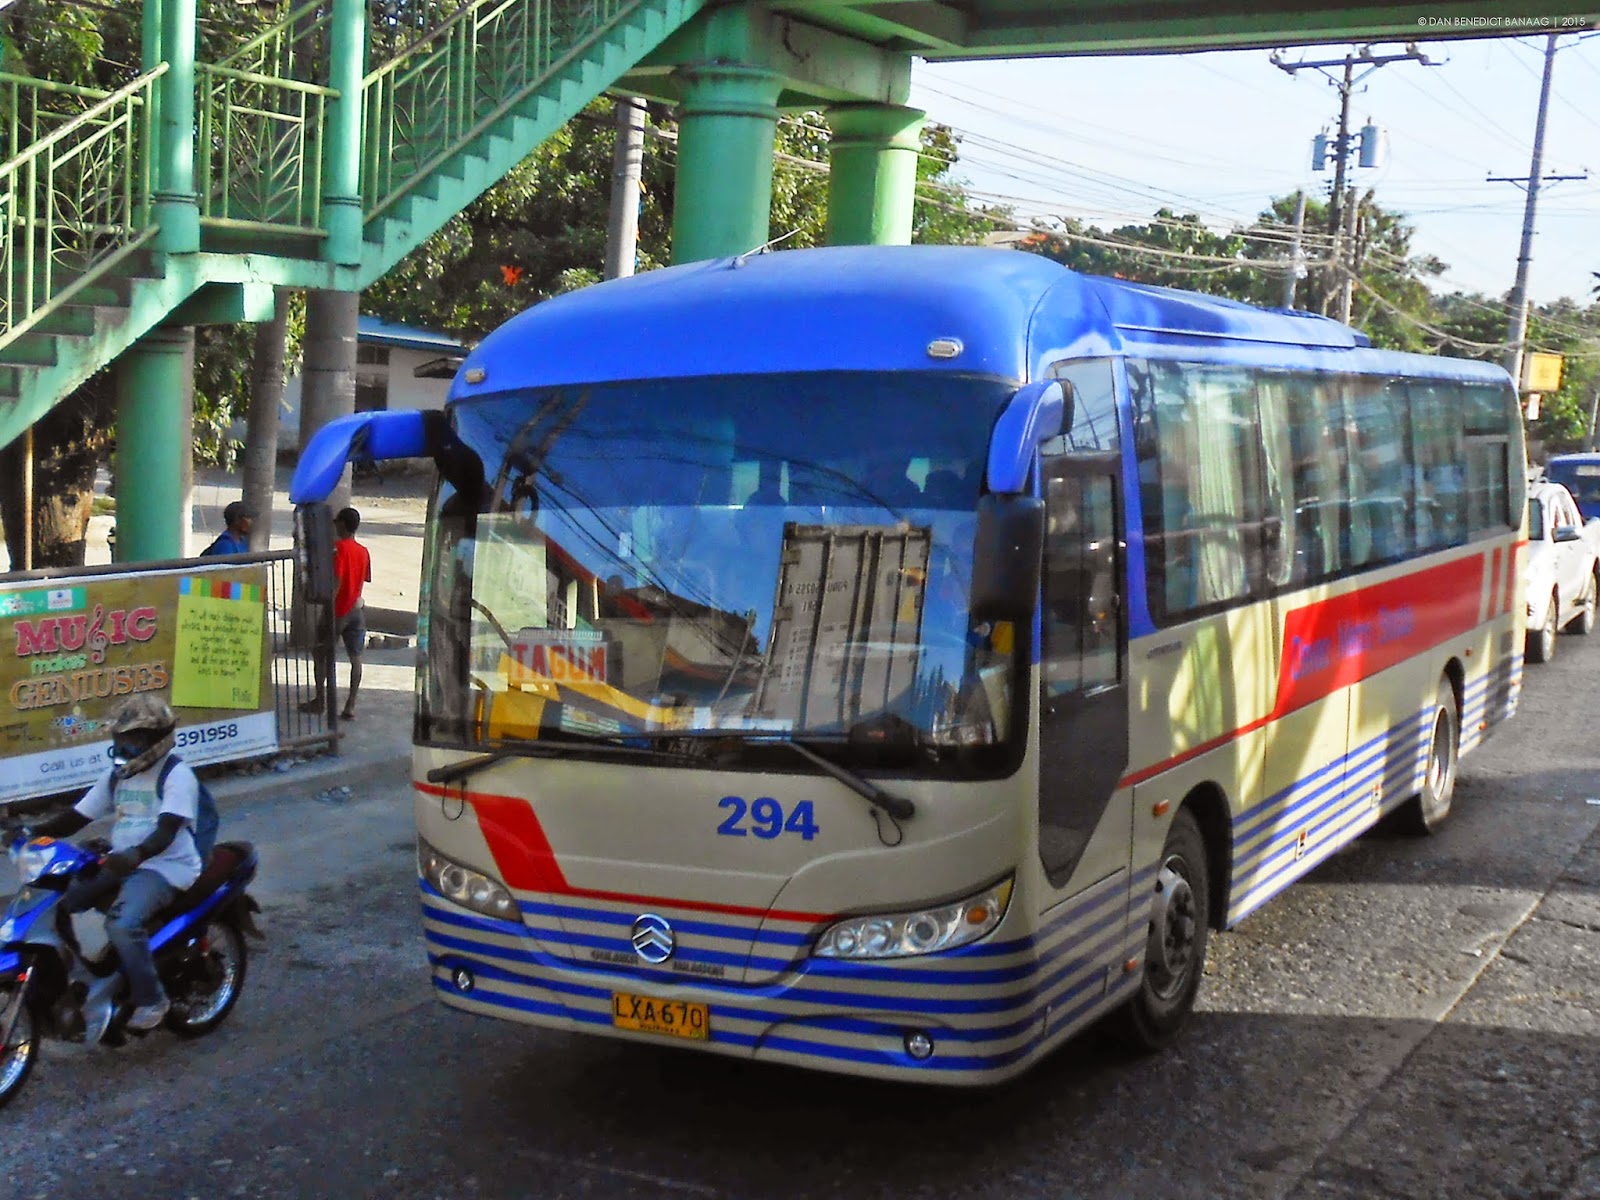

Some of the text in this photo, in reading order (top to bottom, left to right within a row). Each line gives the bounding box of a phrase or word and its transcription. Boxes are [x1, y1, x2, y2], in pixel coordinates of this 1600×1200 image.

[14, 604, 158, 664] MUSIC
[10, 661, 169, 710] GENIUSES
[31, 653, 88, 675] makes
[512, 643, 607, 681] TAGUM
[40, 759, 66, 773] Call
[70, 758, 85, 768] us
[89, 753, 102, 765] at
[174, 723, 238, 748] 391958
[717, 796, 820, 841] 294
